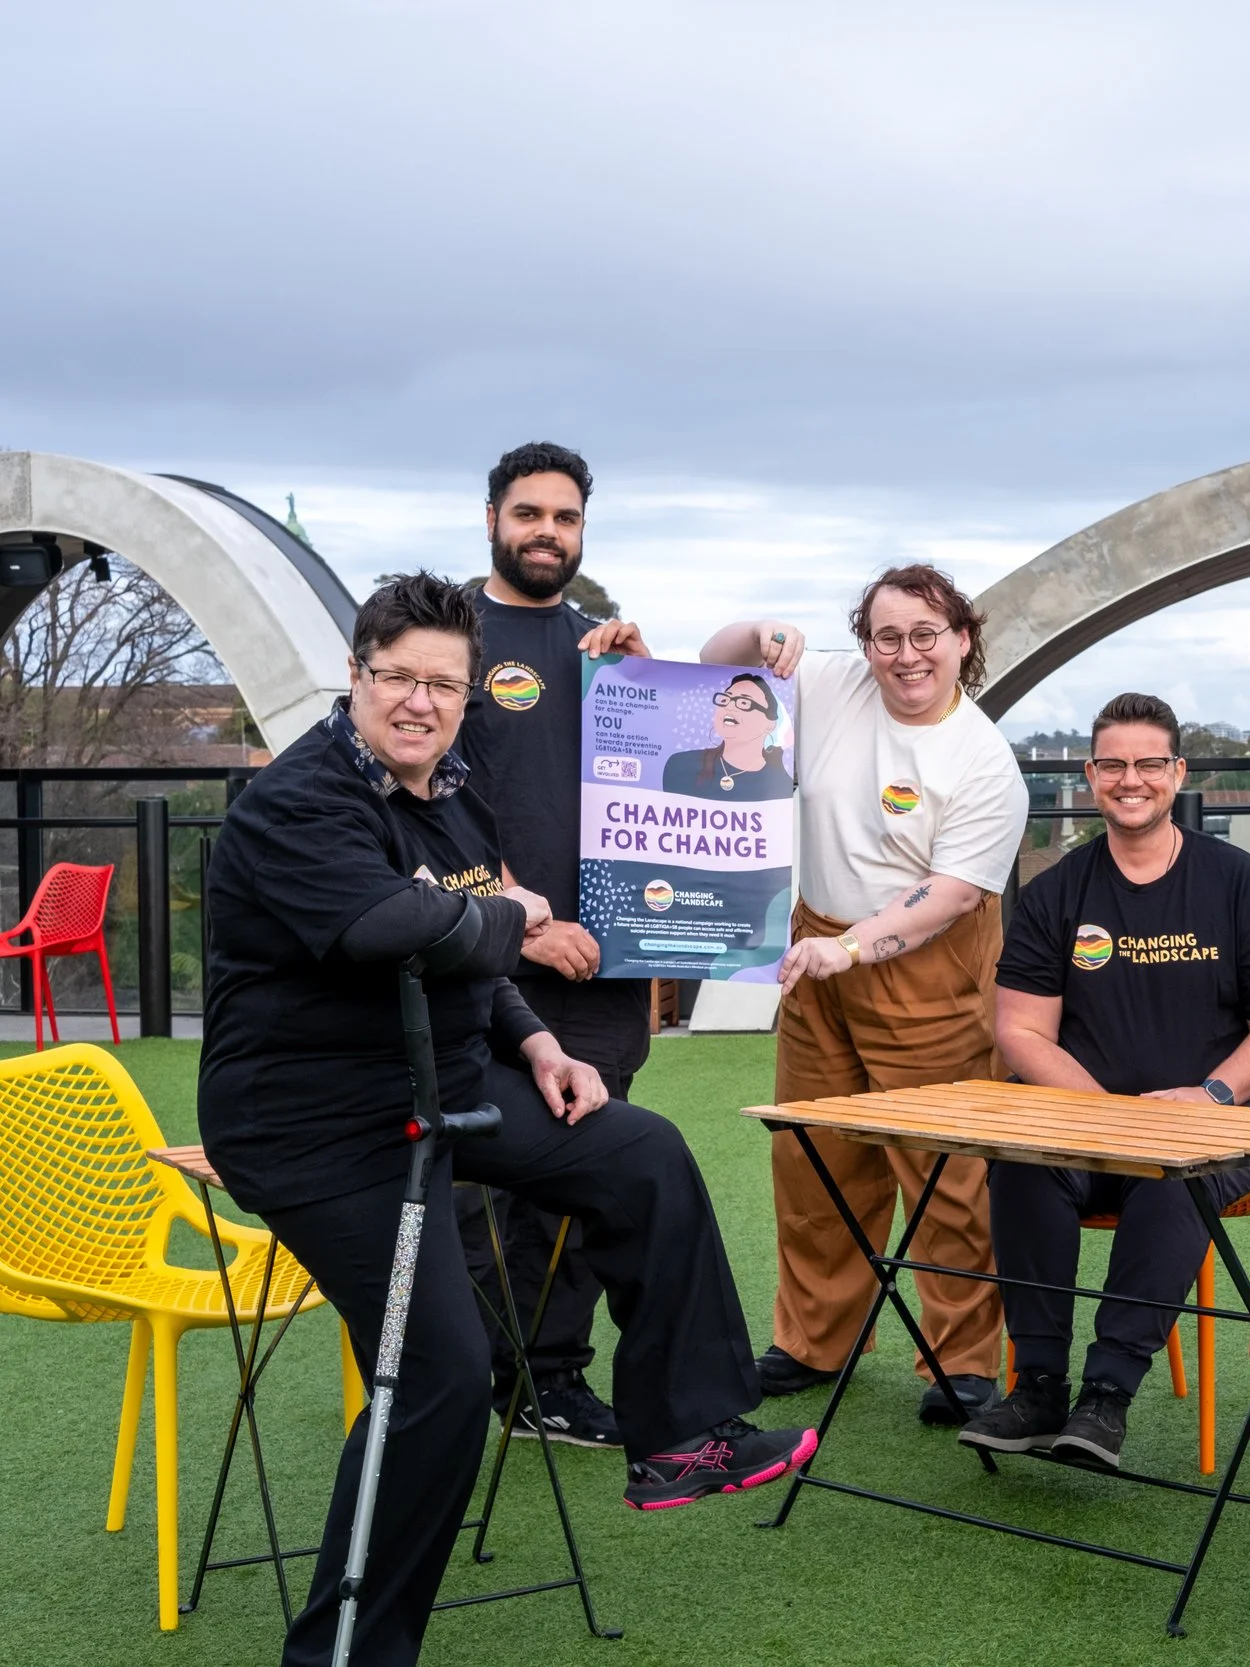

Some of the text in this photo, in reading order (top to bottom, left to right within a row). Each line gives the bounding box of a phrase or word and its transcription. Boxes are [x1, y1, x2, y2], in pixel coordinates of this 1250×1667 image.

[483, 663, 503, 691] CHANGING
[517, 661, 546, 690] LANDSCAPE
[595, 683, 657, 701] ANYONE
[625, 702, 659, 710] champion
[594, 715, 622, 729] YOU
[596, 738, 662, 751] towards preventing
[596, 745, 632, 754] LGBTIQA+SB
[606, 801, 762, 833] CHAMPIONS
[601, 828, 767, 859] FOR CHANGE
[674, 890, 714, 900] CHANGING
[681, 898, 724, 907] LANDSCAPE
[1118, 933, 1197, 950] CHANGING
[1132, 947, 1219, 964] LANDSCAPE
